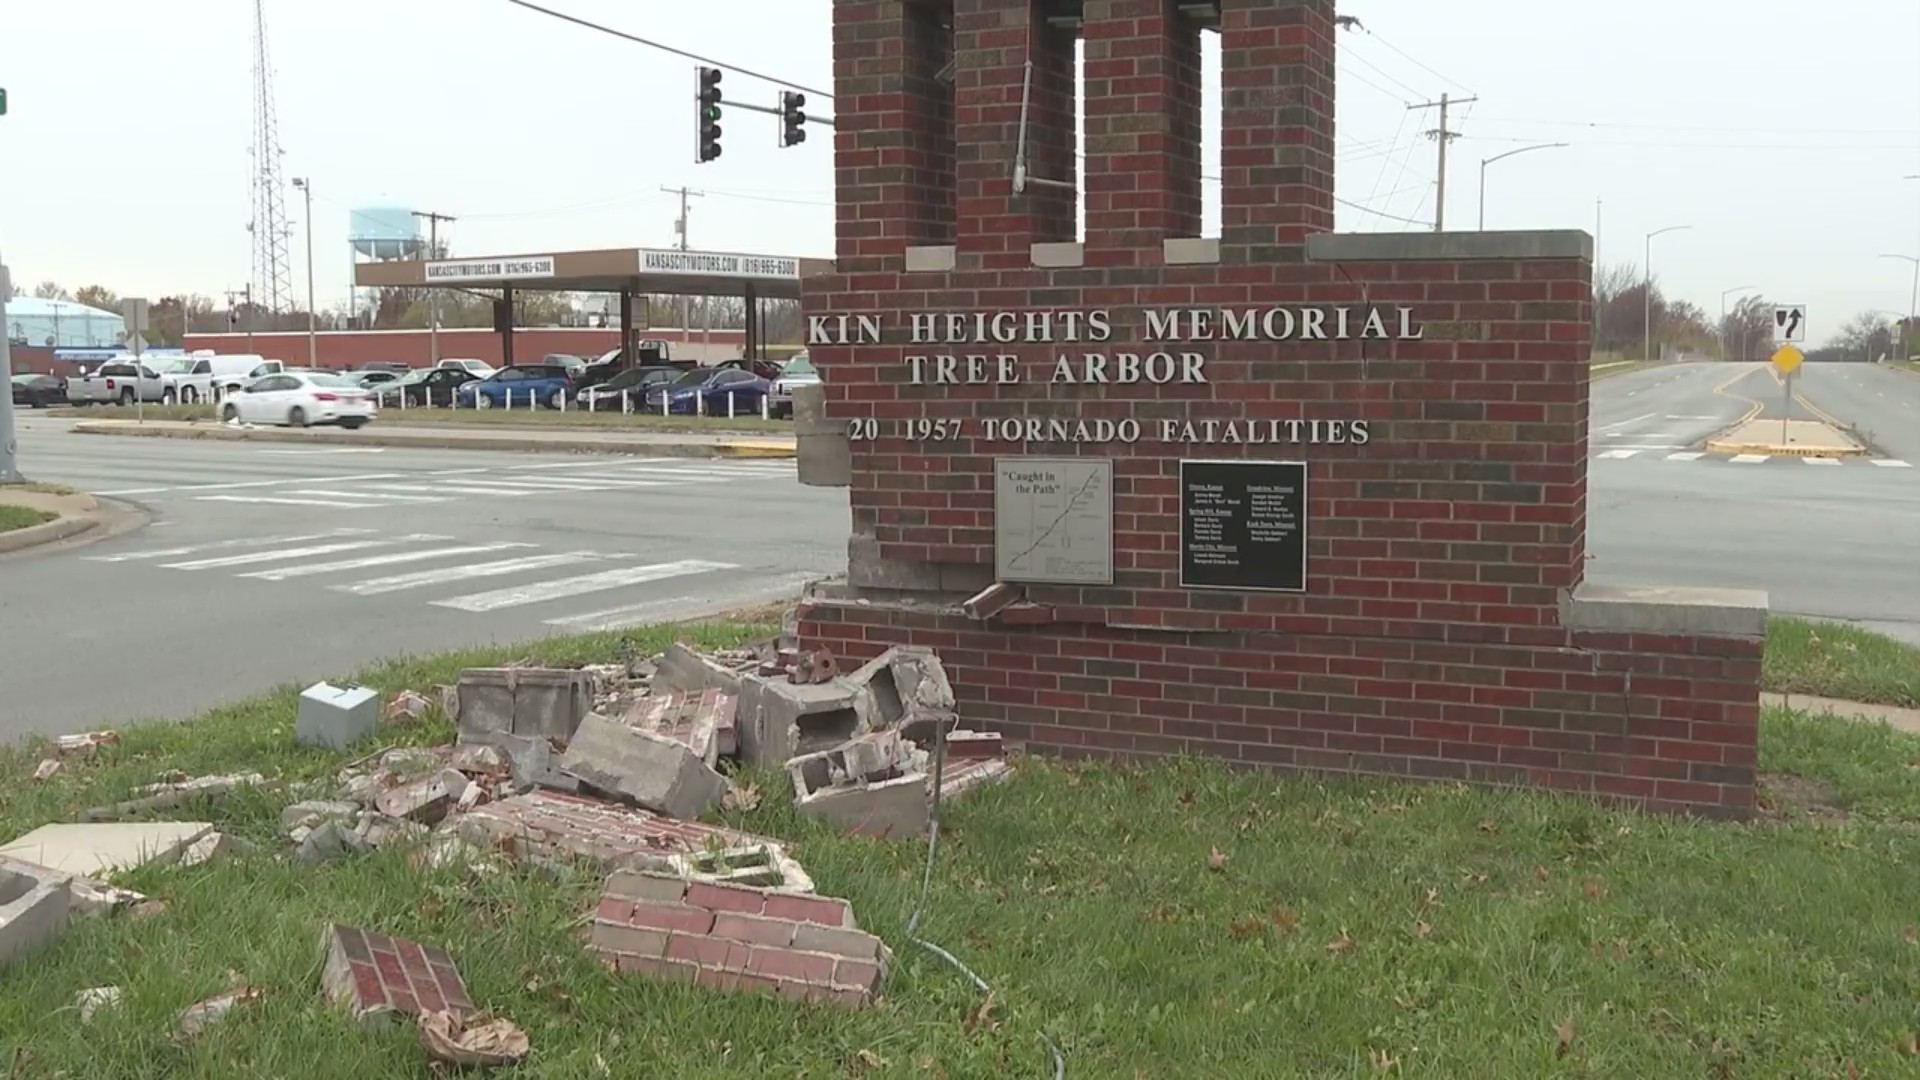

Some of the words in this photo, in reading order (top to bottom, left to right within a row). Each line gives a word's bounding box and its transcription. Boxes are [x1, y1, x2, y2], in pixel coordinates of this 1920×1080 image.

[646, 253, 738, 272] KANSASCITYMOTORS.COM
[808, 313, 882, 345] KIN
[910, 309, 1111, 343] HEIGHTS
[1143, 307, 1424, 342] MEMORIAL
[904, 353, 1021, 385] TREE
[1051, 352, 1208, 384] ARBOR
[849, 417, 878, 441] 20
[905, 418, 962, 441] 1957
[981, 418, 1142, 443] TORNADO
[1162, 418, 1370, 444] FATALITIES
[1003, 471, 1043, 483] "Caught
[1045, 471, 1055, 481] in
[1016, 485, 1030, 494] the
[1033, 484, 1060, 495] Path"
